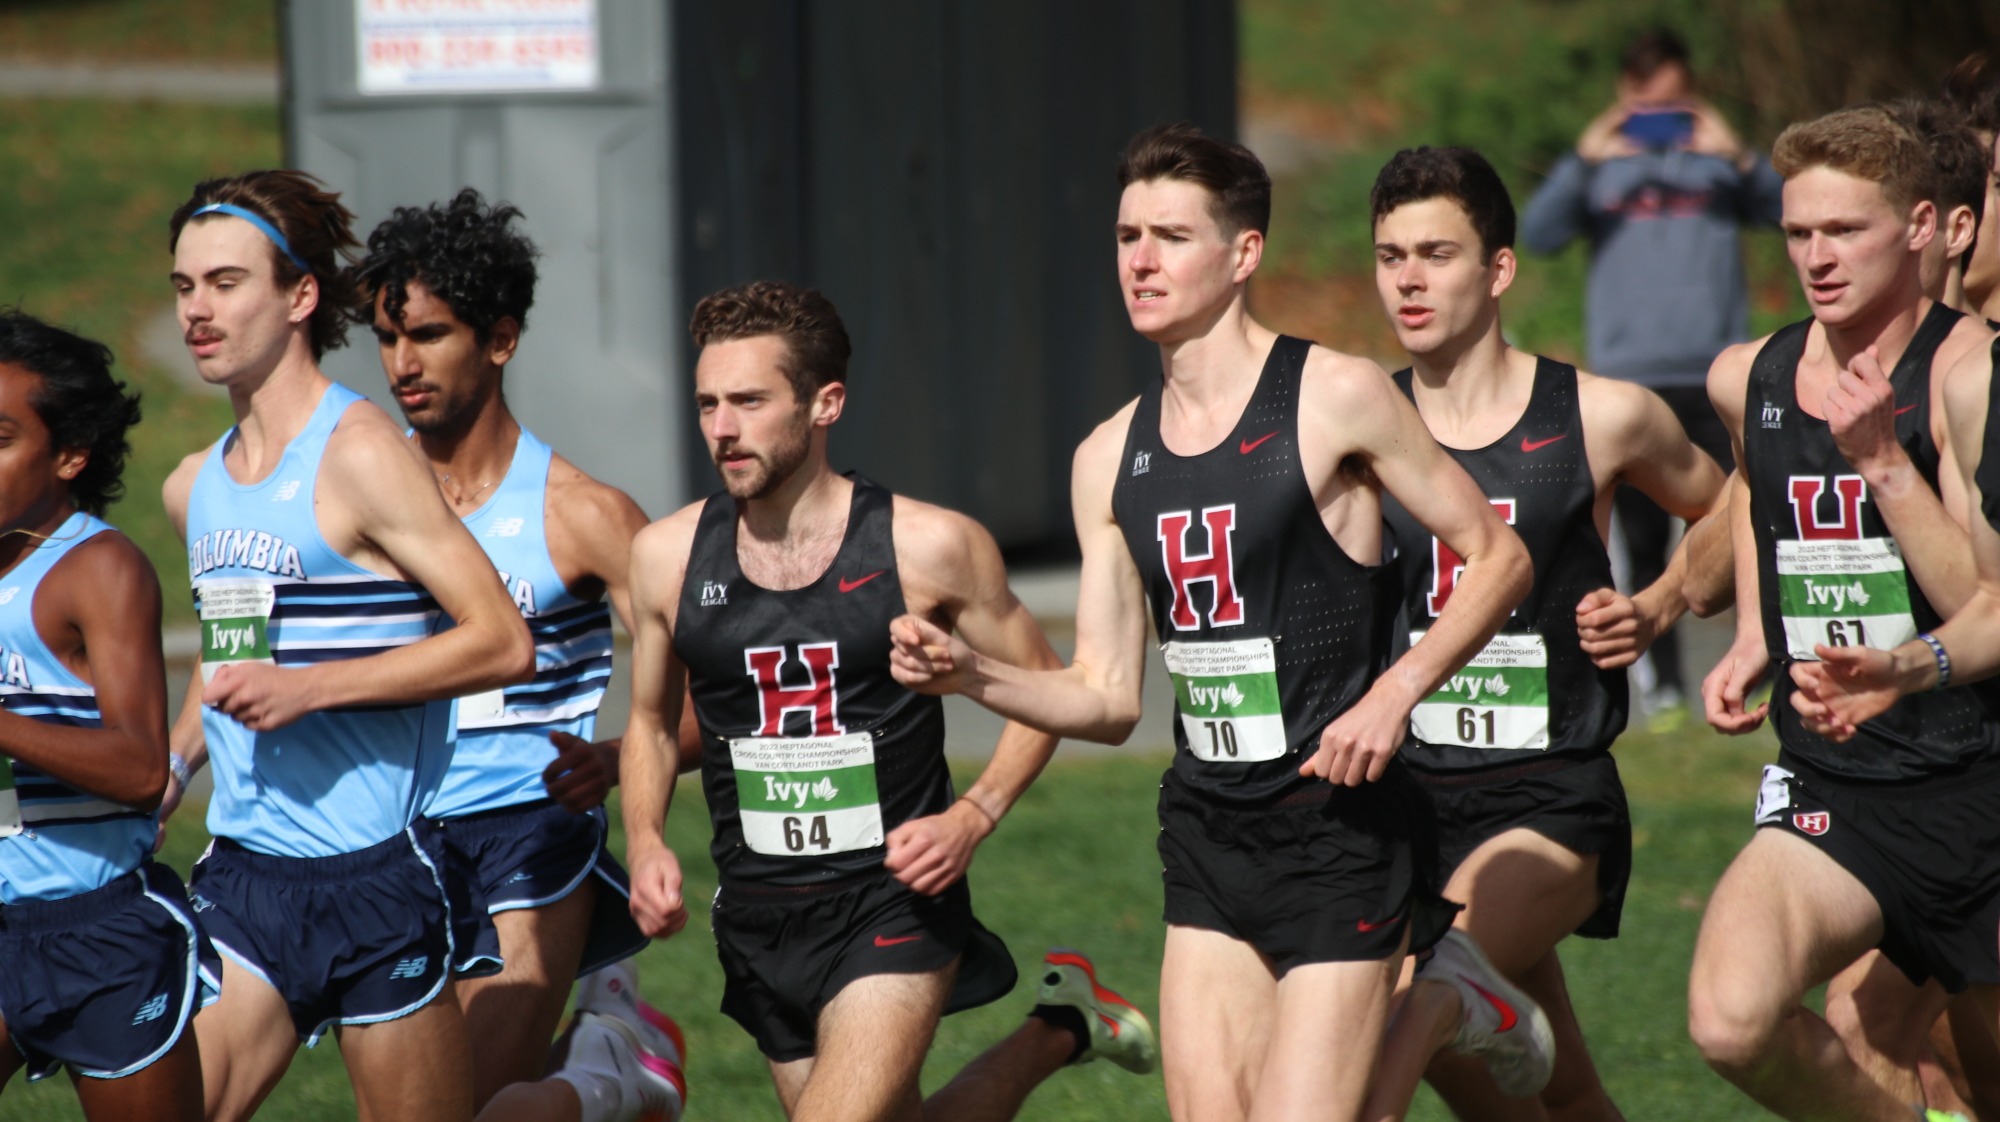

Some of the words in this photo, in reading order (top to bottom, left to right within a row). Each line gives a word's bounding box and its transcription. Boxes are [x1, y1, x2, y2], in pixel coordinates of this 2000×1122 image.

[1761, 407, 1785, 421] IVY
[1133, 452, 1152, 470] IVY
[189, 528, 307, 581] OLUMBIA
[1157, 503, 1245, 631] H
[701, 584, 728, 599] IVY
[1804, 579, 1846, 612] Ivy
[211, 622, 243, 656] Ivy
[1826, 619, 1866, 648] 67
[1192, 646, 1238, 655] HEPTAGONAL
[1207, 652, 1270, 664] CHAMPIONSHIPS
[1481, 648, 1542, 656] AMPIONSHIPS
[1226, 664, 1248, 673] PARK
[1495, 657, 1518, 665] PARK
[744, 640, 847, 738] H
[1187, 680, 1220, 713] Ivy
[1456, 707, 1495, 745] 61
[759, 743, 779, 751] 2022
[780, 741, 834, 751] HEPTAGONAL
[1204, 720, 1239, 758] 70
[734, 750, 758, 759] CROSS
[758, 752, 796, 760] COUNTRY
[797, 746, 868, 760] CHAMPIONSHIPS
[754, 761, 771, 769] VAN
[771, 761, 819, 770] CORTLANDT
[820, 758, 844, 768] PARK
[763, 776, 810, 809] Ivy
[1803, 816, 1821, 831] H
[783, 815, 832, 853] 64
